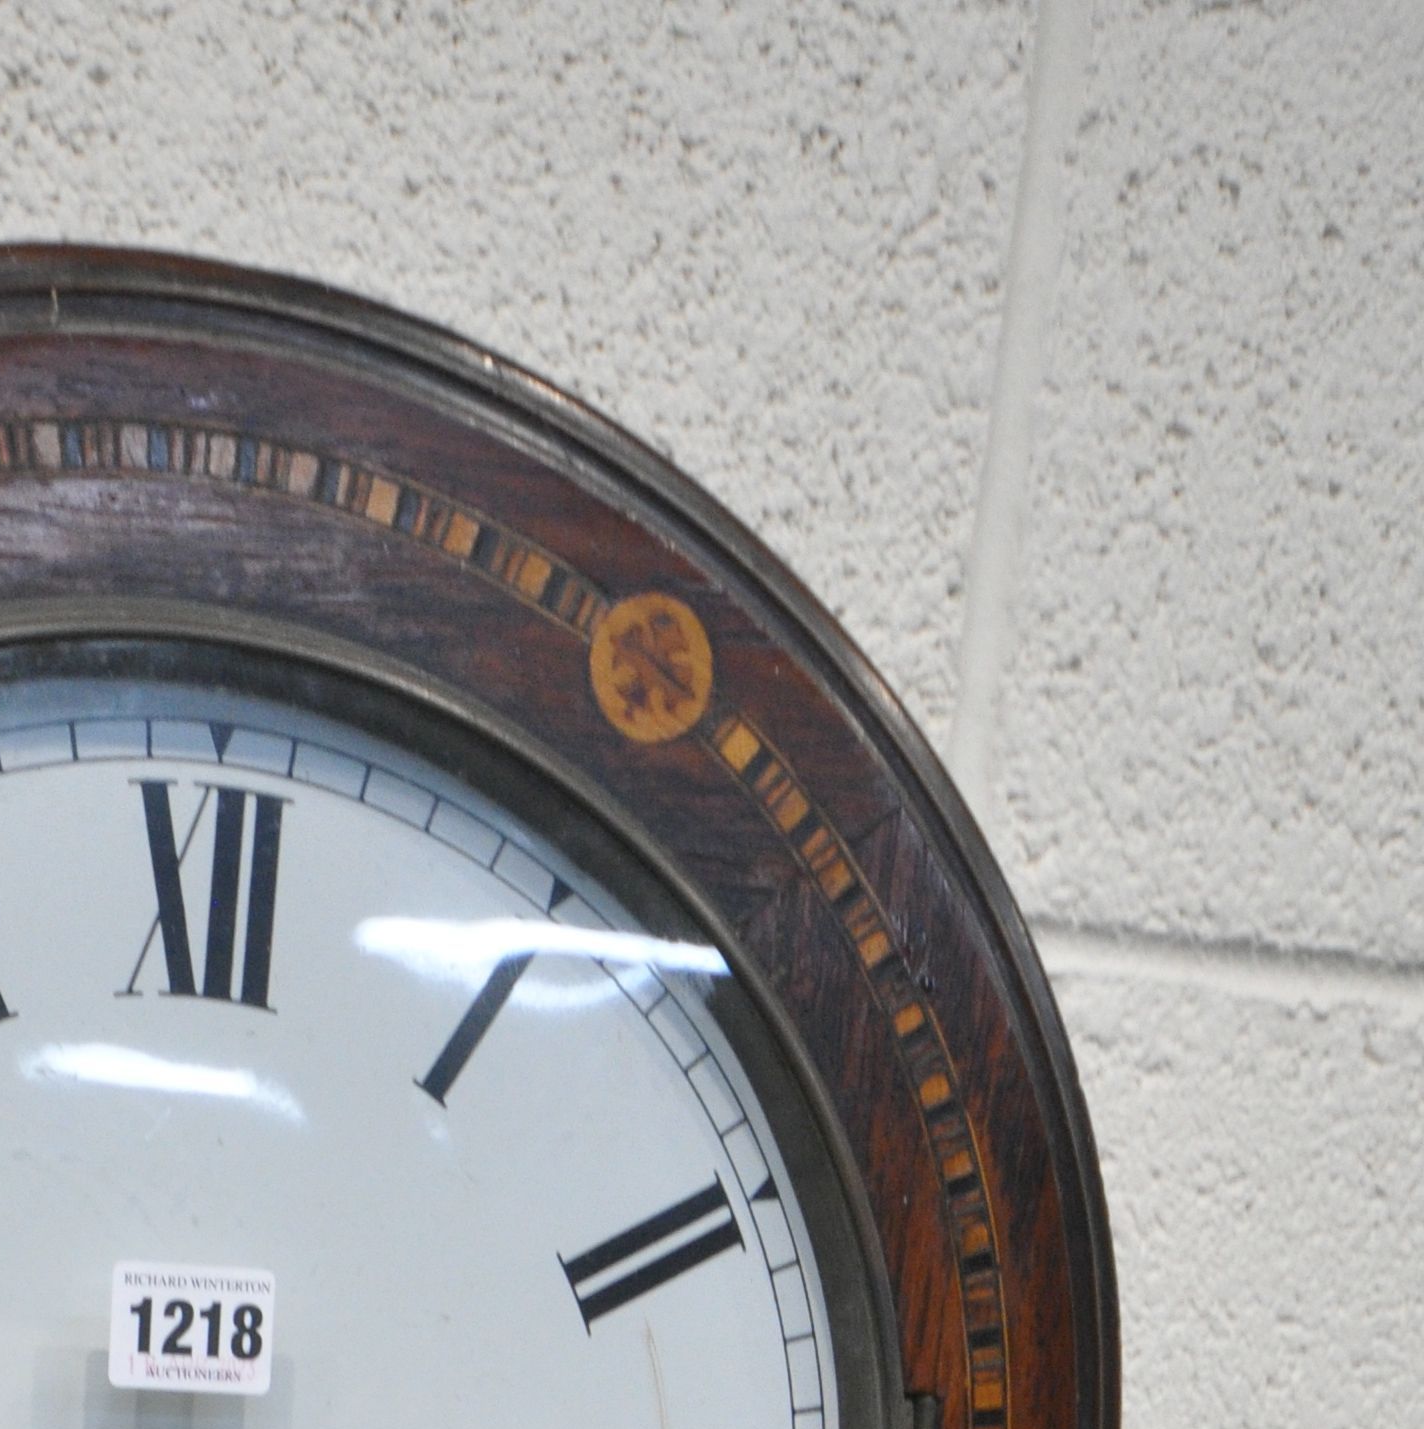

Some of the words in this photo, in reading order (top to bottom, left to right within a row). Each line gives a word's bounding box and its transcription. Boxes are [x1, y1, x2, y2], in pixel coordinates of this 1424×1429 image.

[114, 778, 294, 1015] XII
[124, 1271, 187, 1288] RICHARD
[190, 1275, 271, 1295] WINTERTON
[556, 1169, 746, 1337] II
[130, 1296, 263, 1361] 1218
[146, 1365, 242, 1383] AUCTIONEERS
